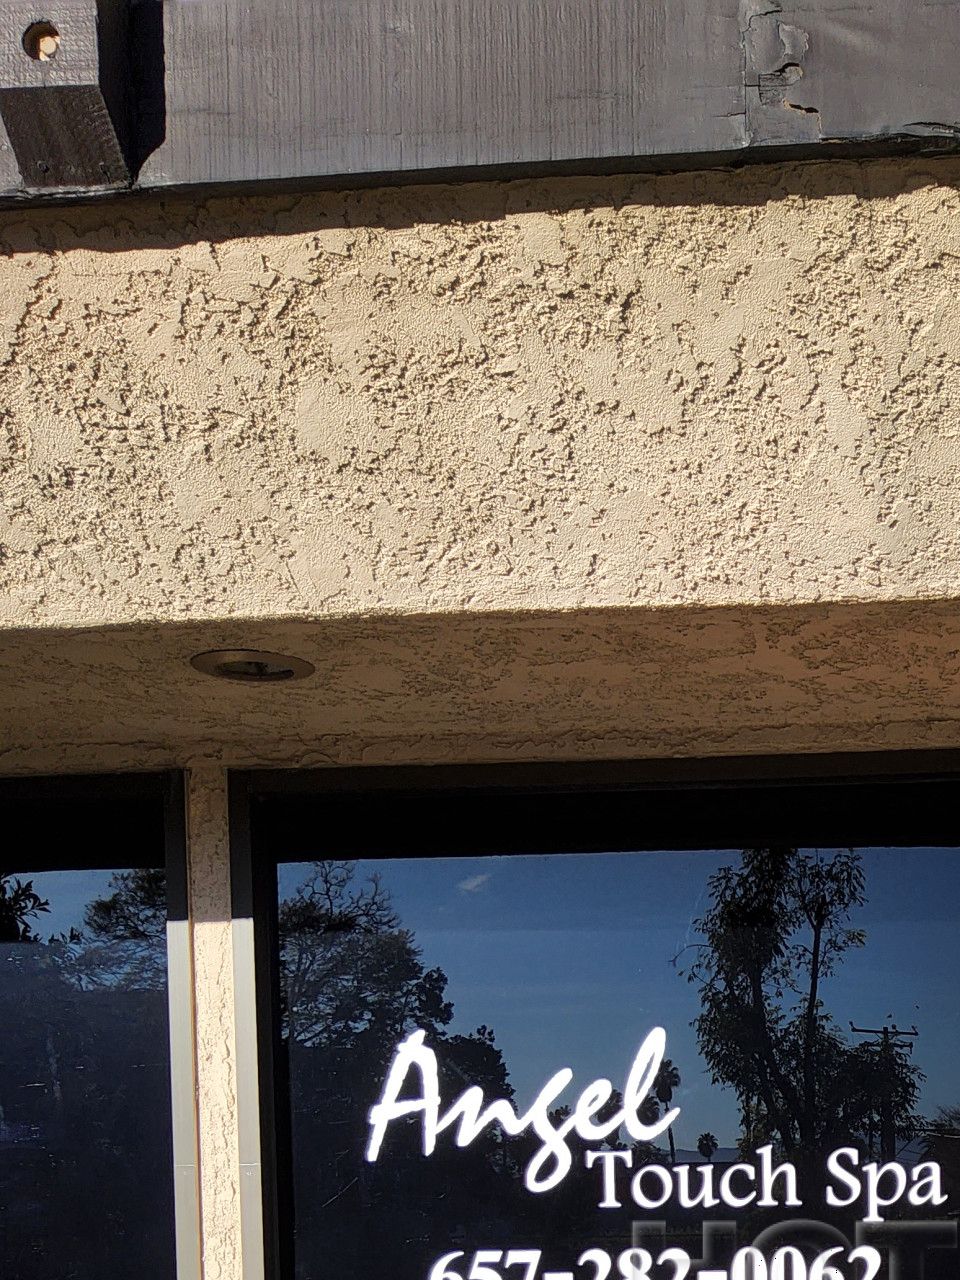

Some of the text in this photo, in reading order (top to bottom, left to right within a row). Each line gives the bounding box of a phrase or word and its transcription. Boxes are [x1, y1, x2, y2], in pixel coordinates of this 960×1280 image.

[366, 1026, 680, 1194] Angel
[587, 1144, 948, 1222] Touch Spa
